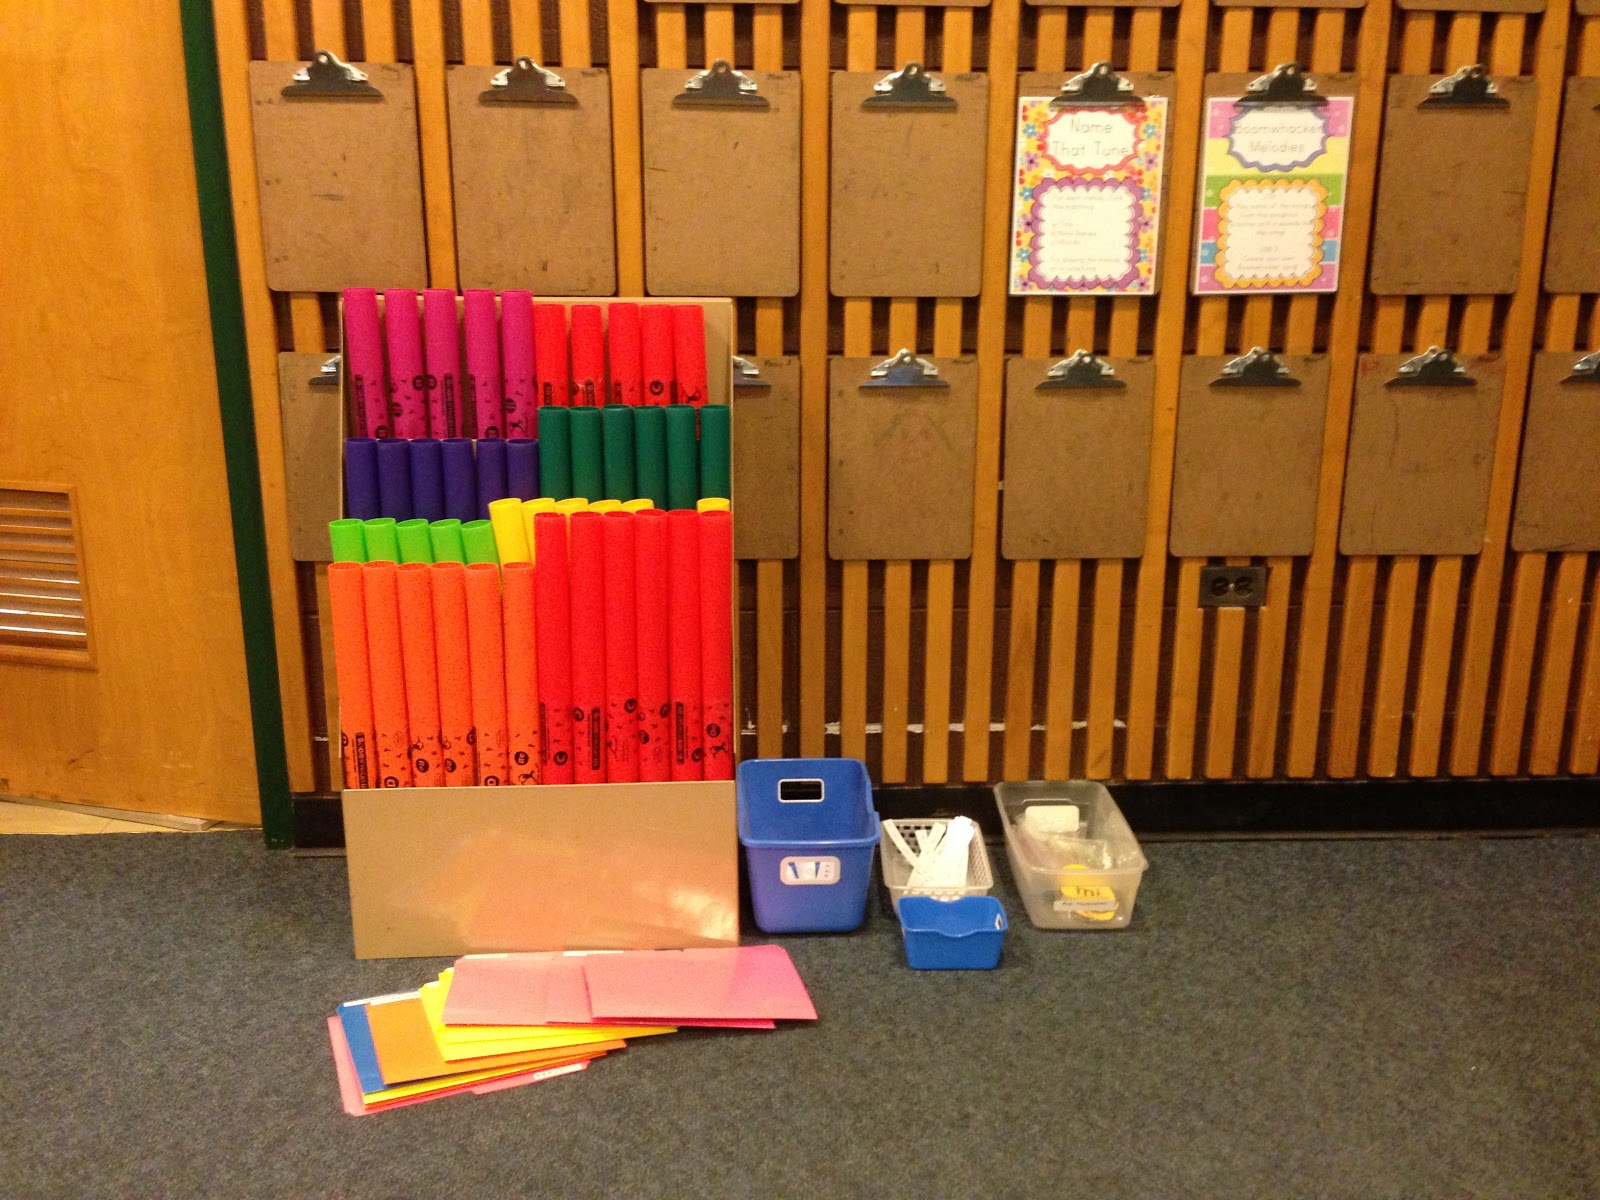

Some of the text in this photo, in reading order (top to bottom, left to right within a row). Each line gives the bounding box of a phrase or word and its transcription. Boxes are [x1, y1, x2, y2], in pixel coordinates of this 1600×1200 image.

[1069, 118, 1113, 134] Name
[1052, 140, 1129, 157] That Tune
